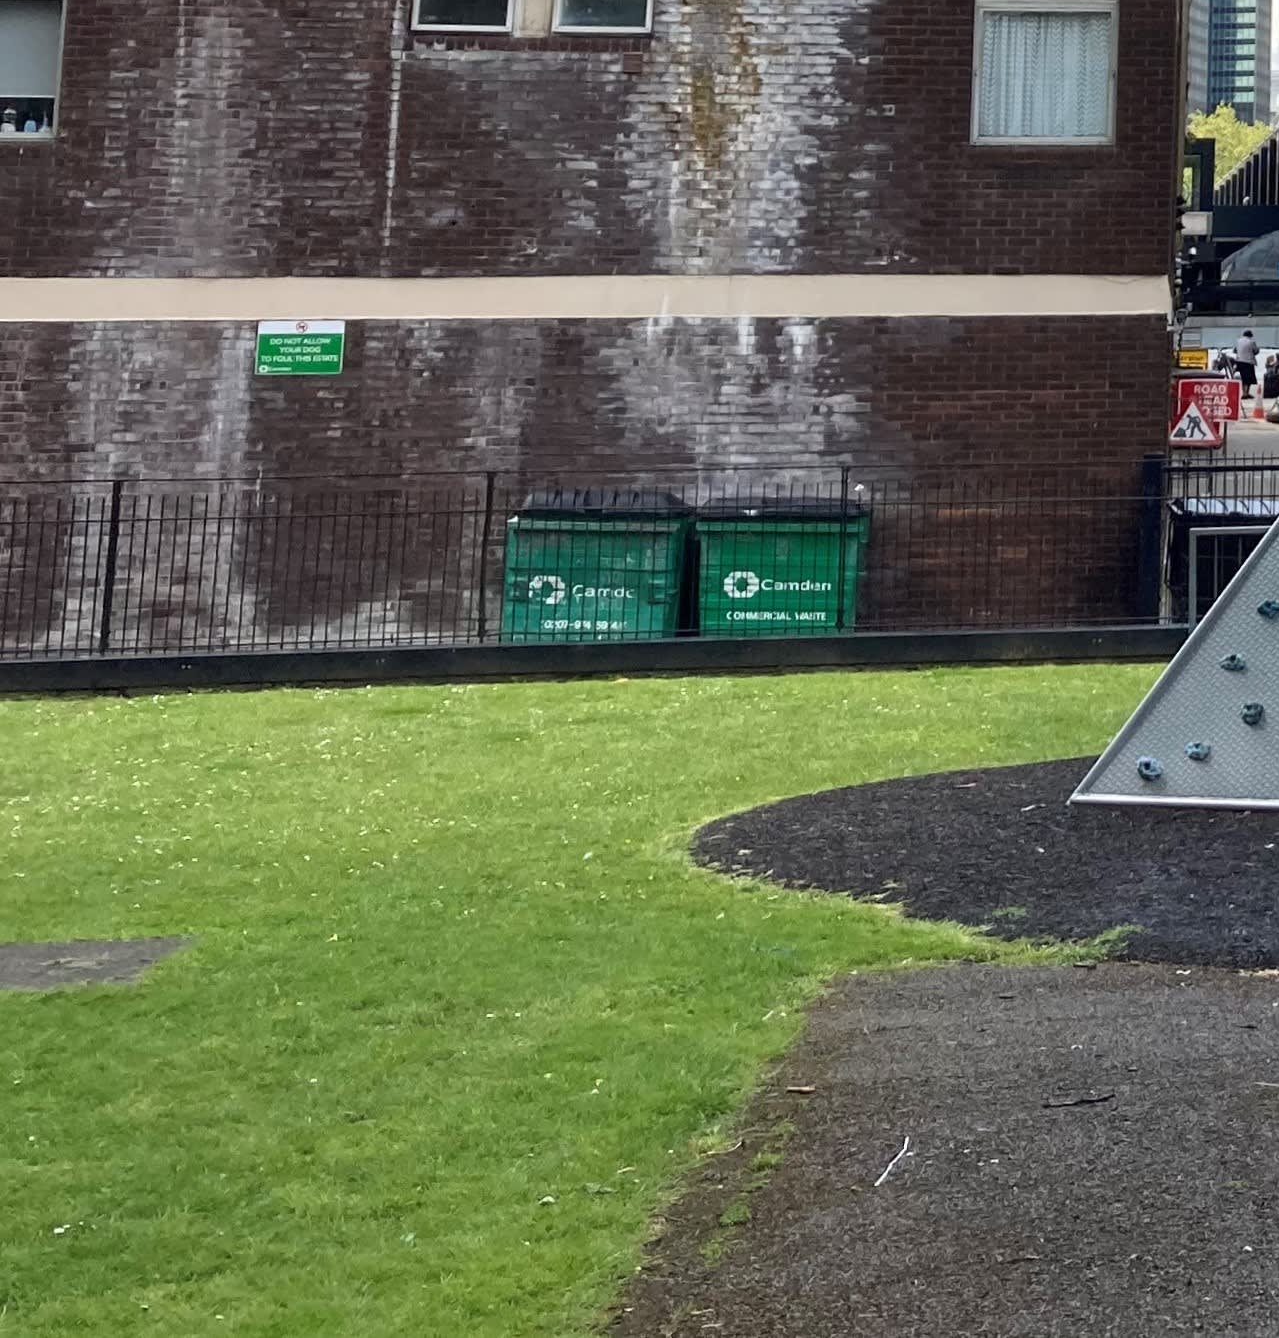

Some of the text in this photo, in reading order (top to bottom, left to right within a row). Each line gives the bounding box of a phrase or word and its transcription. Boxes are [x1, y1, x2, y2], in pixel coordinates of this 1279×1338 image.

[269, 337, 332, 345] DO NOT ALLOW
[261, 355, 272, 363] TO
[1193, 384, 1227, 395] ROAD
[1198, 395, 1229, 406] HEAD
[760, 579, 832, 591] Camden
